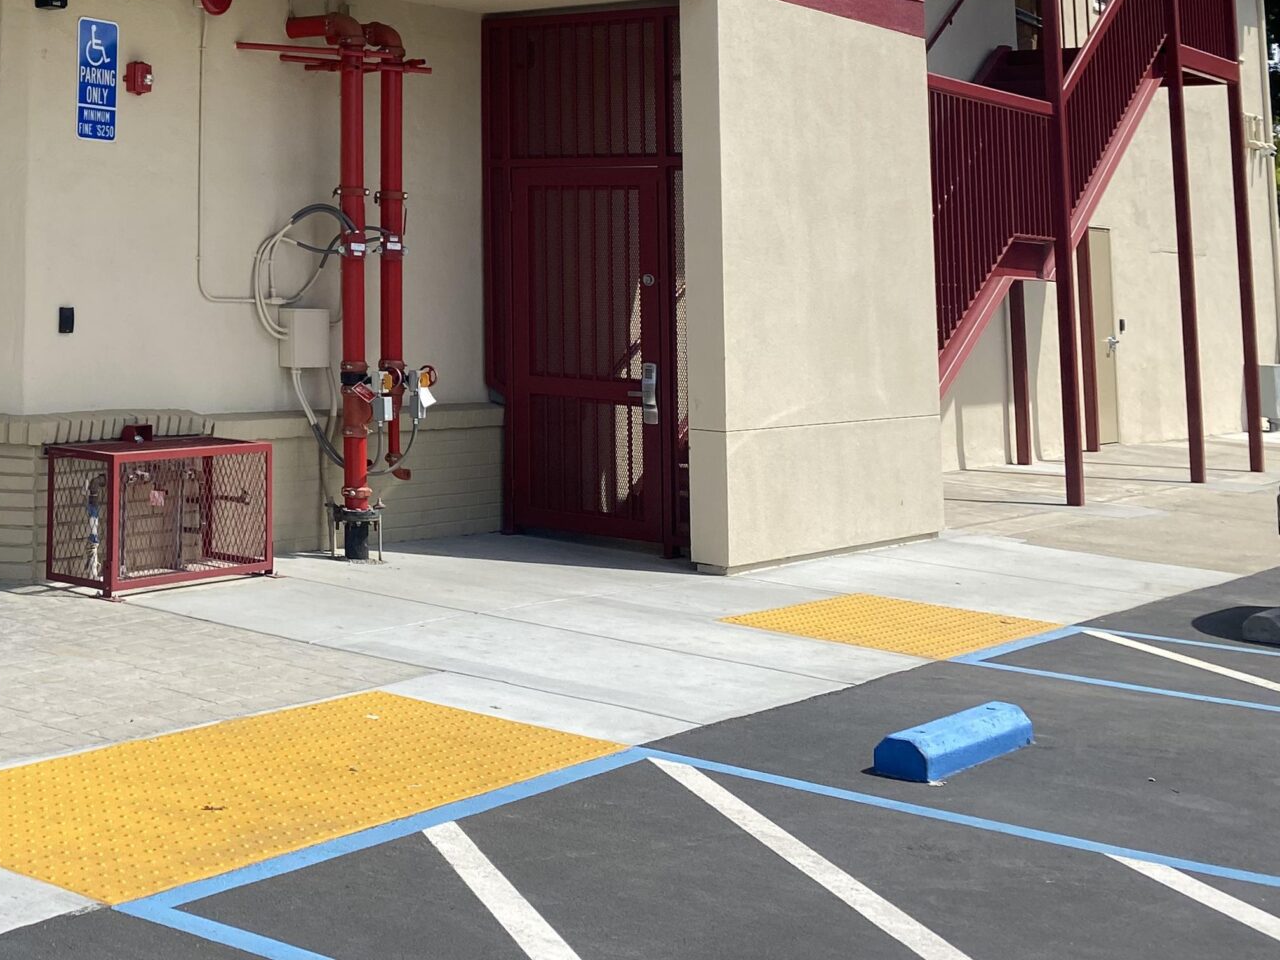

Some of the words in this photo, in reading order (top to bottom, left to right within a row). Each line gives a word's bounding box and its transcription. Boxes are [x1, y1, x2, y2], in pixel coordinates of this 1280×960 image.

[80, 66, 115, 87] PARKING
[86, 86, 109, 105] ONLY
[83, 109, 110, 123] MINIMUM
[79, 122, 93, 135] FINE
[96, 125, 114, 138] $250
